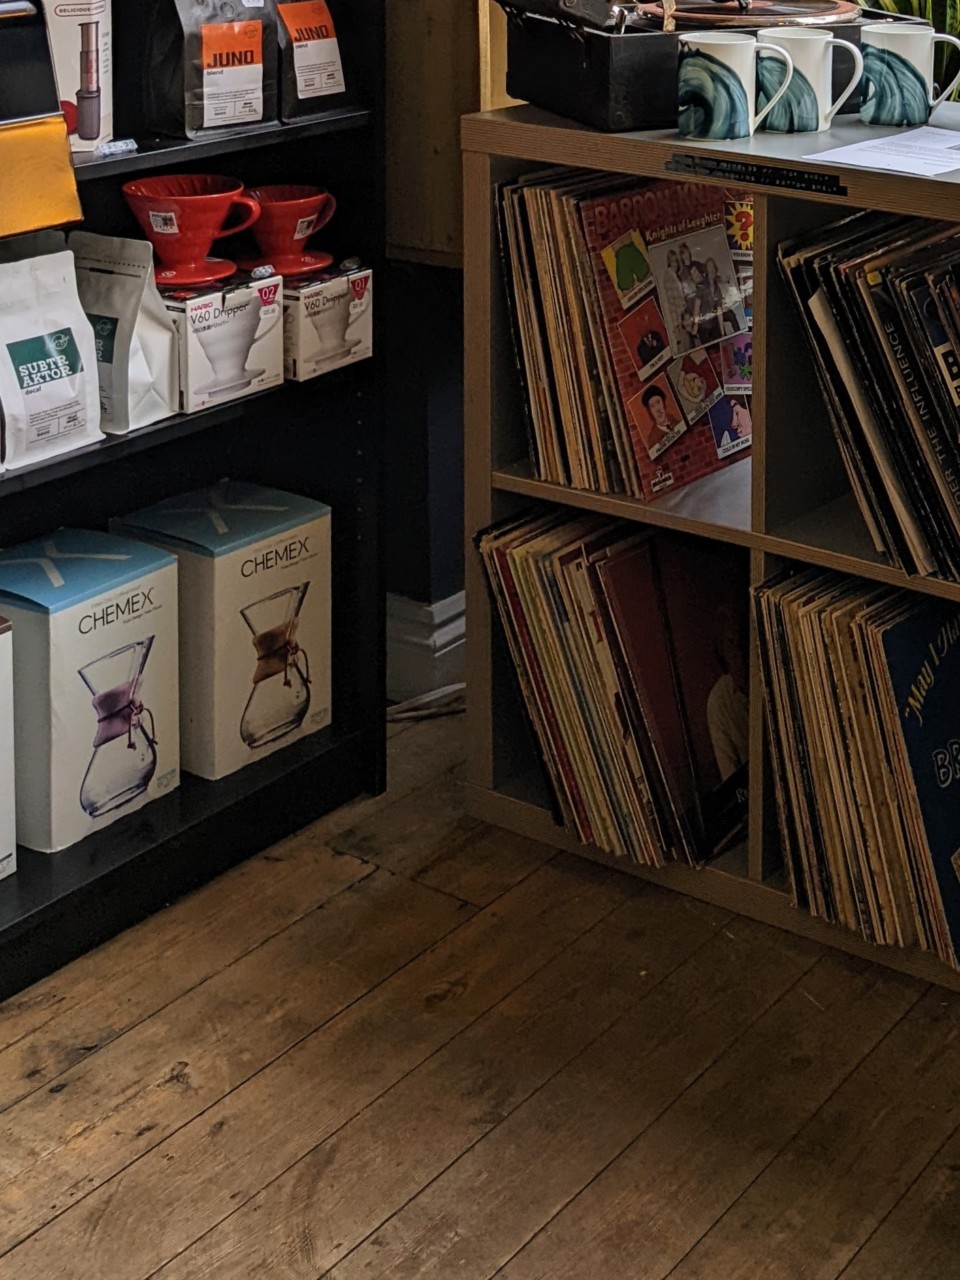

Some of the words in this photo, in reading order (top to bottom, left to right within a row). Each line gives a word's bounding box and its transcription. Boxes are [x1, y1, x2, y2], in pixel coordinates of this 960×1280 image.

[294, 24, 329, 42] JUNO
[206, 50, 254, 68] JUNO
[645, 222, 677, 242] Knights
[677, 219, 686, 233] of
[686, 212, 722, 231] Laughter
[261, 286, 275, 300] 02
[355, 278, 365, 291] 01
[190, 302, 214, 313] HARIO
[303, 298, 320, 311] V60
[322, 292, 349, 307] Dripper
[190, 312, 211, 325] V60
[213, 303, 249, 319] Dripper
[19, 355, 69, 376] SUBTR
[884, 320, 929, 421] INFLUENCE
[22, 365, 73, 388] AKTOR
[926, 424, 947, 465] THE
[240, 536, 310, 578] CHEMEX
[78, 587, 155, 635] CHEMEX
